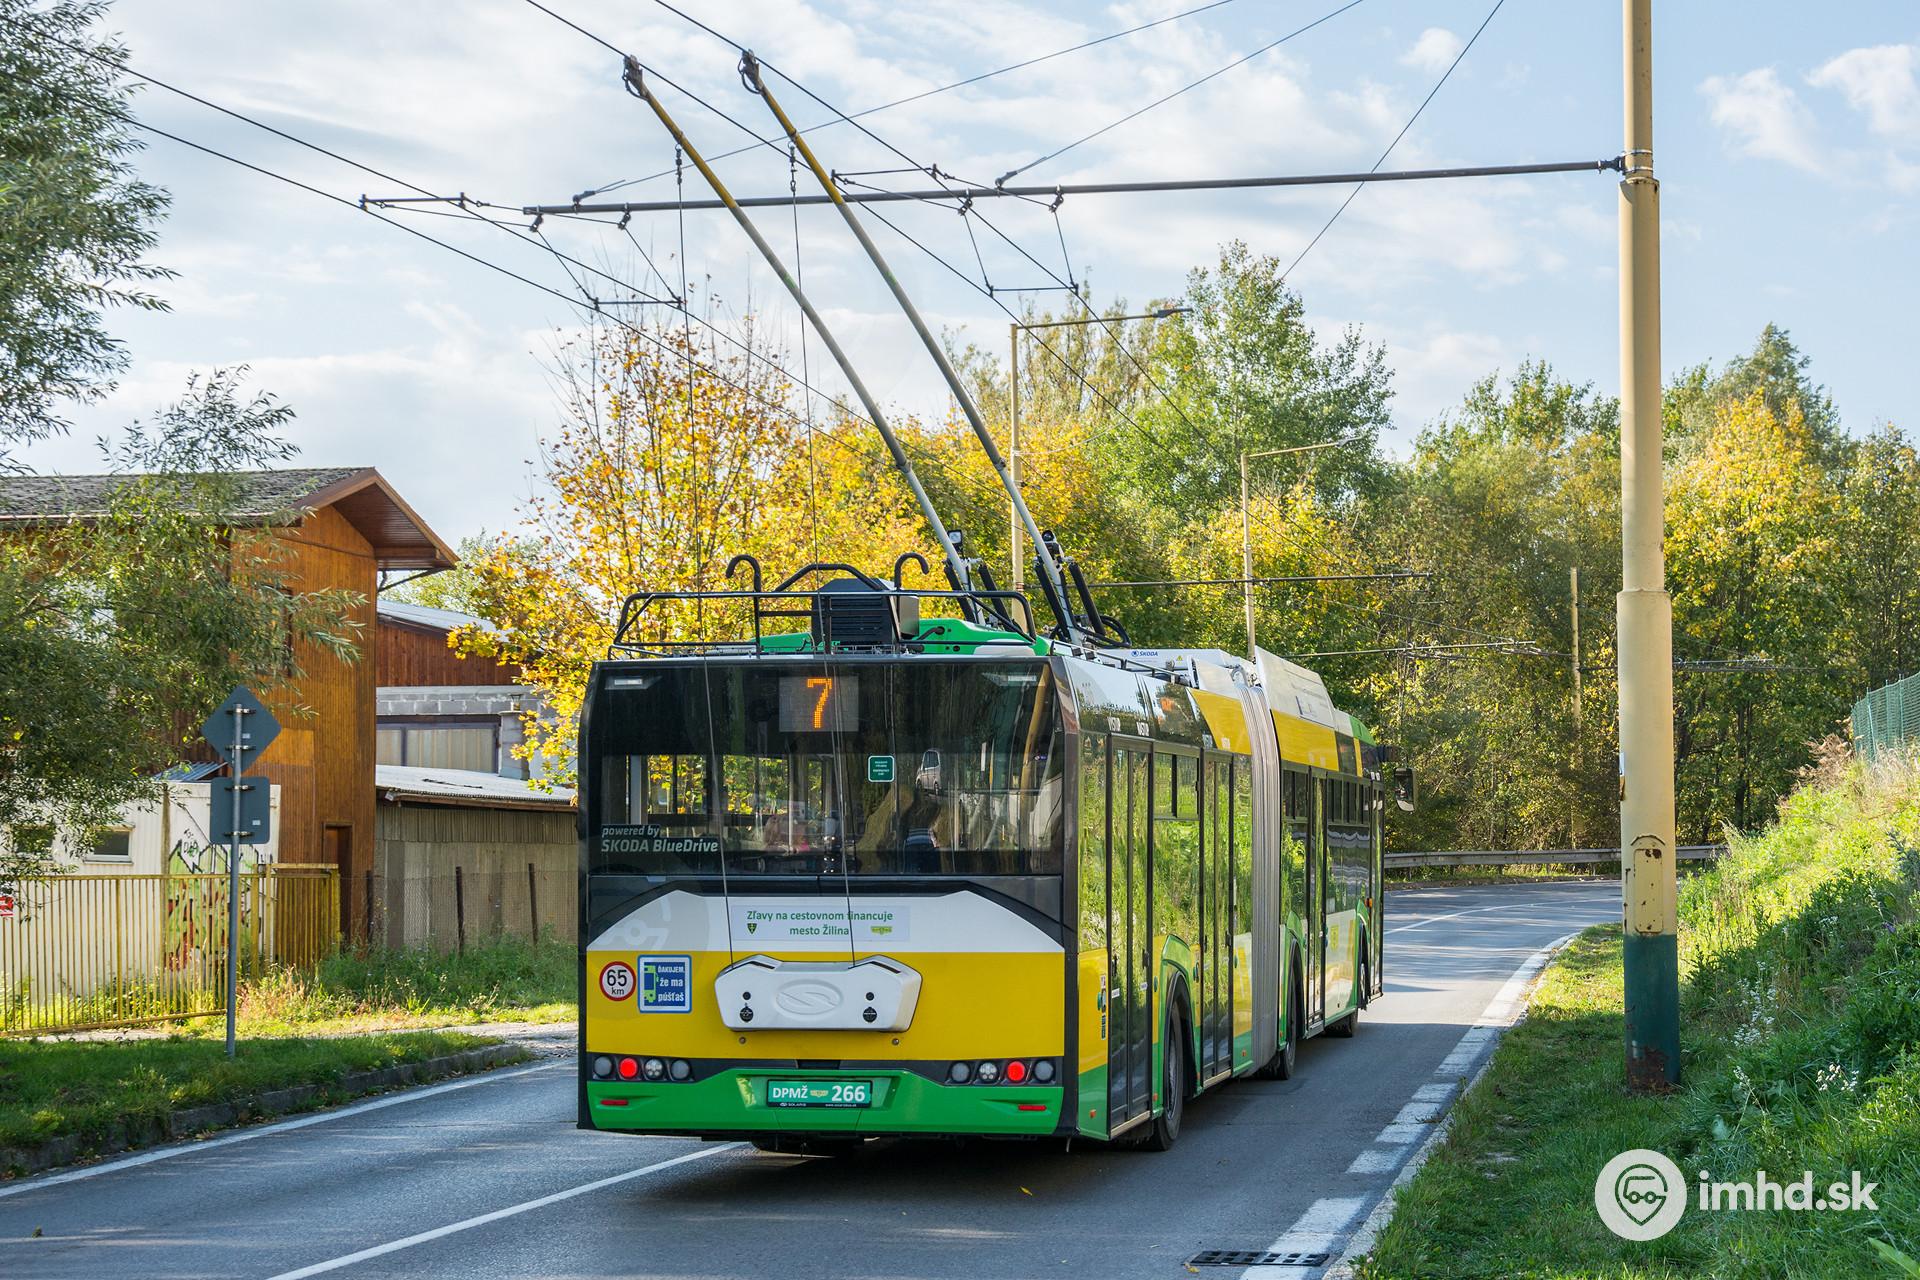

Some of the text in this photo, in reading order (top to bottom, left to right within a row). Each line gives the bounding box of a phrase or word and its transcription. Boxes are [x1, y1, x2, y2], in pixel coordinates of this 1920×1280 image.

[806, 678, 832, 729] 7
[601, 825, 660, 838] powered by
[652, 839, 719, 852] BlueDrive
[747, 910, 773, 922] Zľavy
[775, 912, 788, 920] na
[790, 911, 844, 920] cestovnom
[789, 923, 849, 935] mesto Žilina
[607, 969, 628, 987] 65
[659, 977, 684, 987] že ma
[611, 987, 625, 995] km
[772, 1085, 866, 1102] DPMŽ 266
